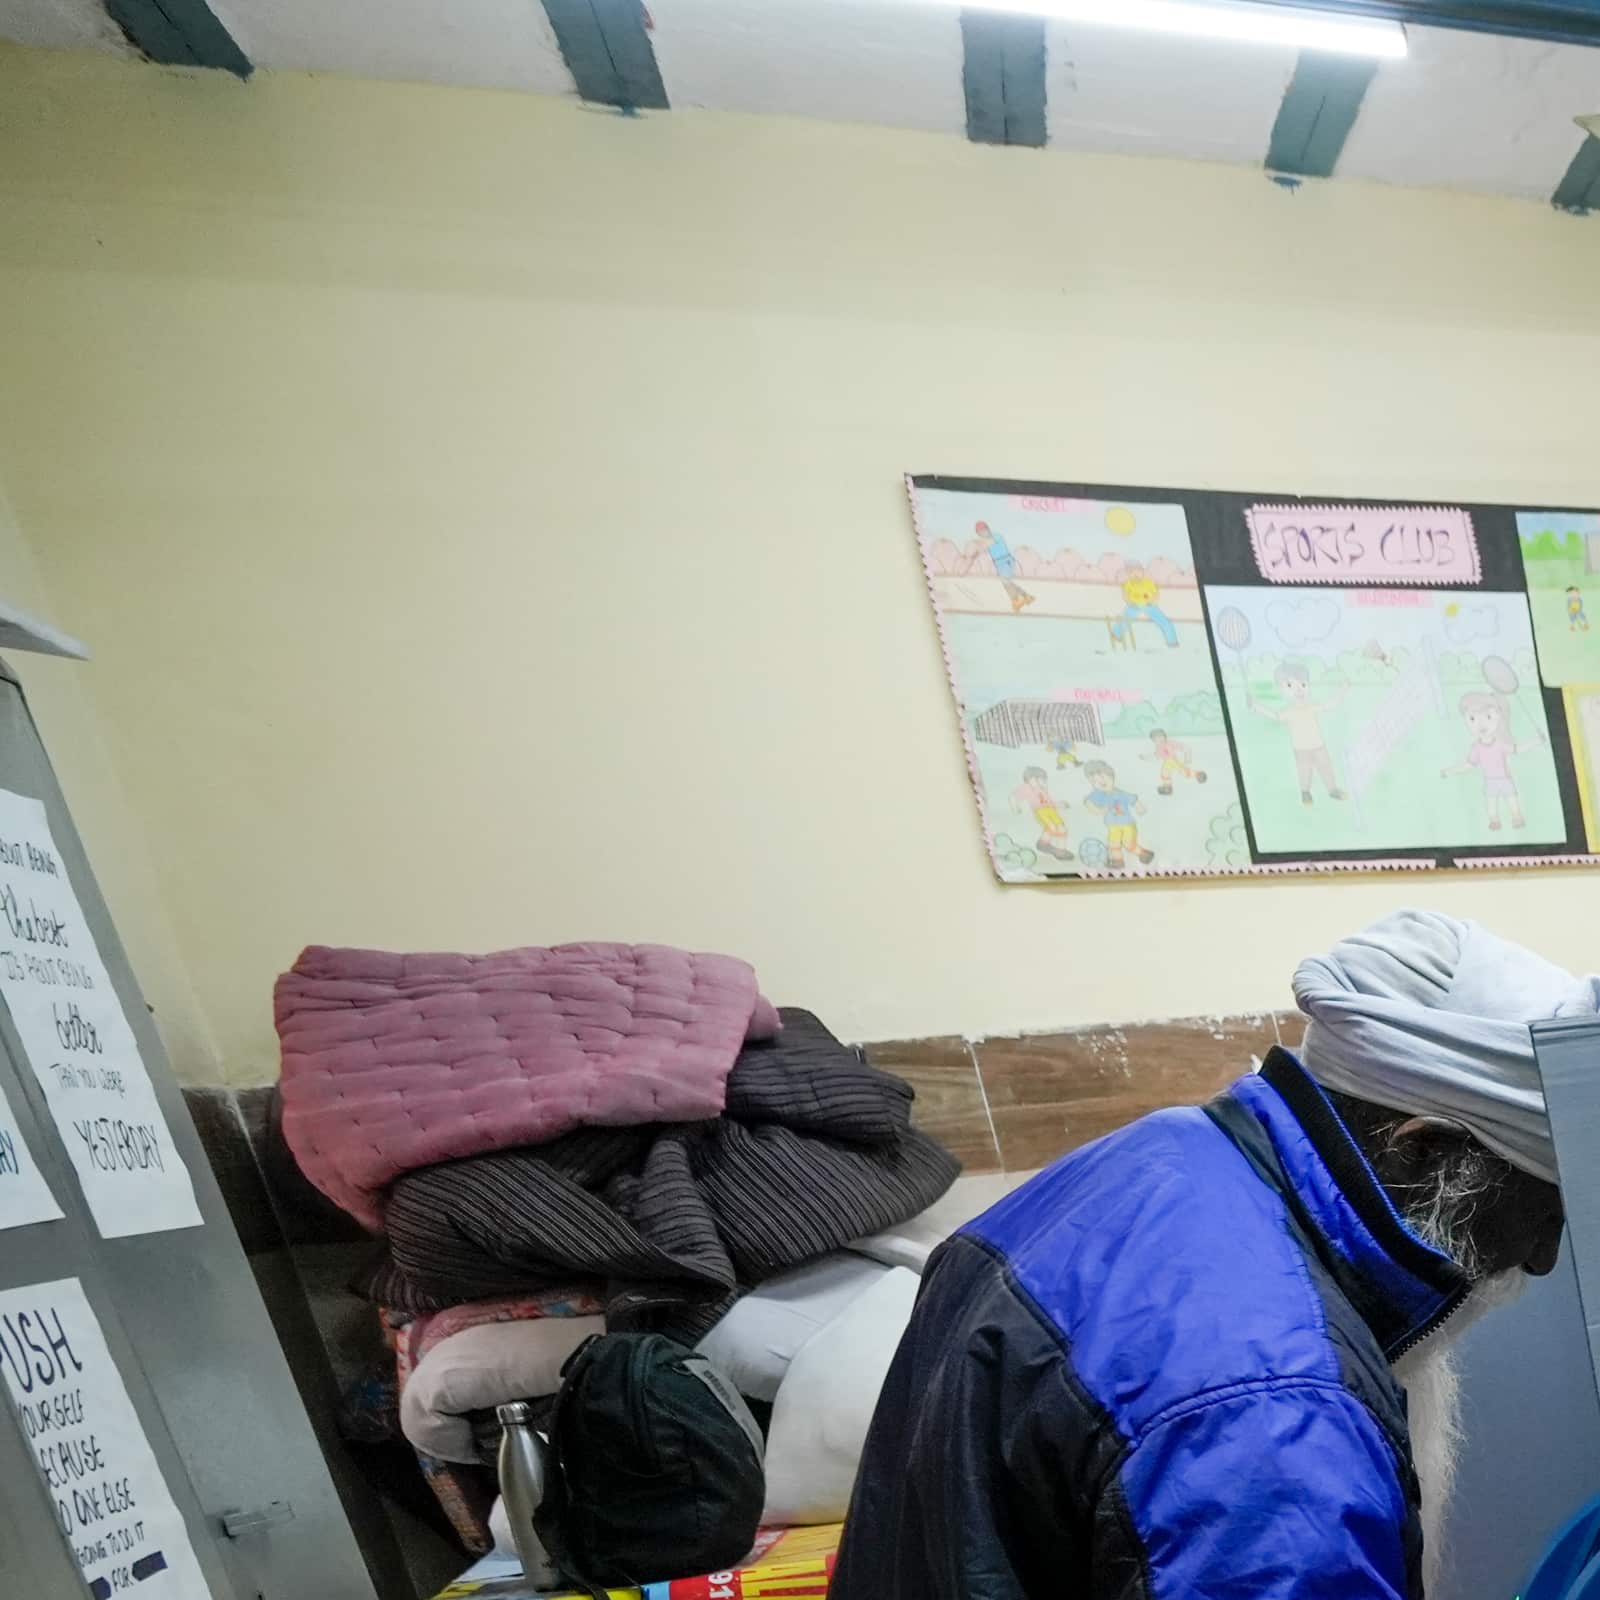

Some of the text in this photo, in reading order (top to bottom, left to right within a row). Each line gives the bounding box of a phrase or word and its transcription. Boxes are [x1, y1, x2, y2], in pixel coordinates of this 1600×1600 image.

[1264, 522, 1456, 568] SPORTS CLUB
[73, 1117, 165, 1173] YESTERDAY
[0, 1307, 82, 1394] USH
[103, 1477, 136, 1514] ELSE
[106, 1532, 121, 1555] TO
[118, 1528, 135, 1551] DO
[134, 1521, 145, 1542] IT
[112, 1567, 135, 1593] FOR
